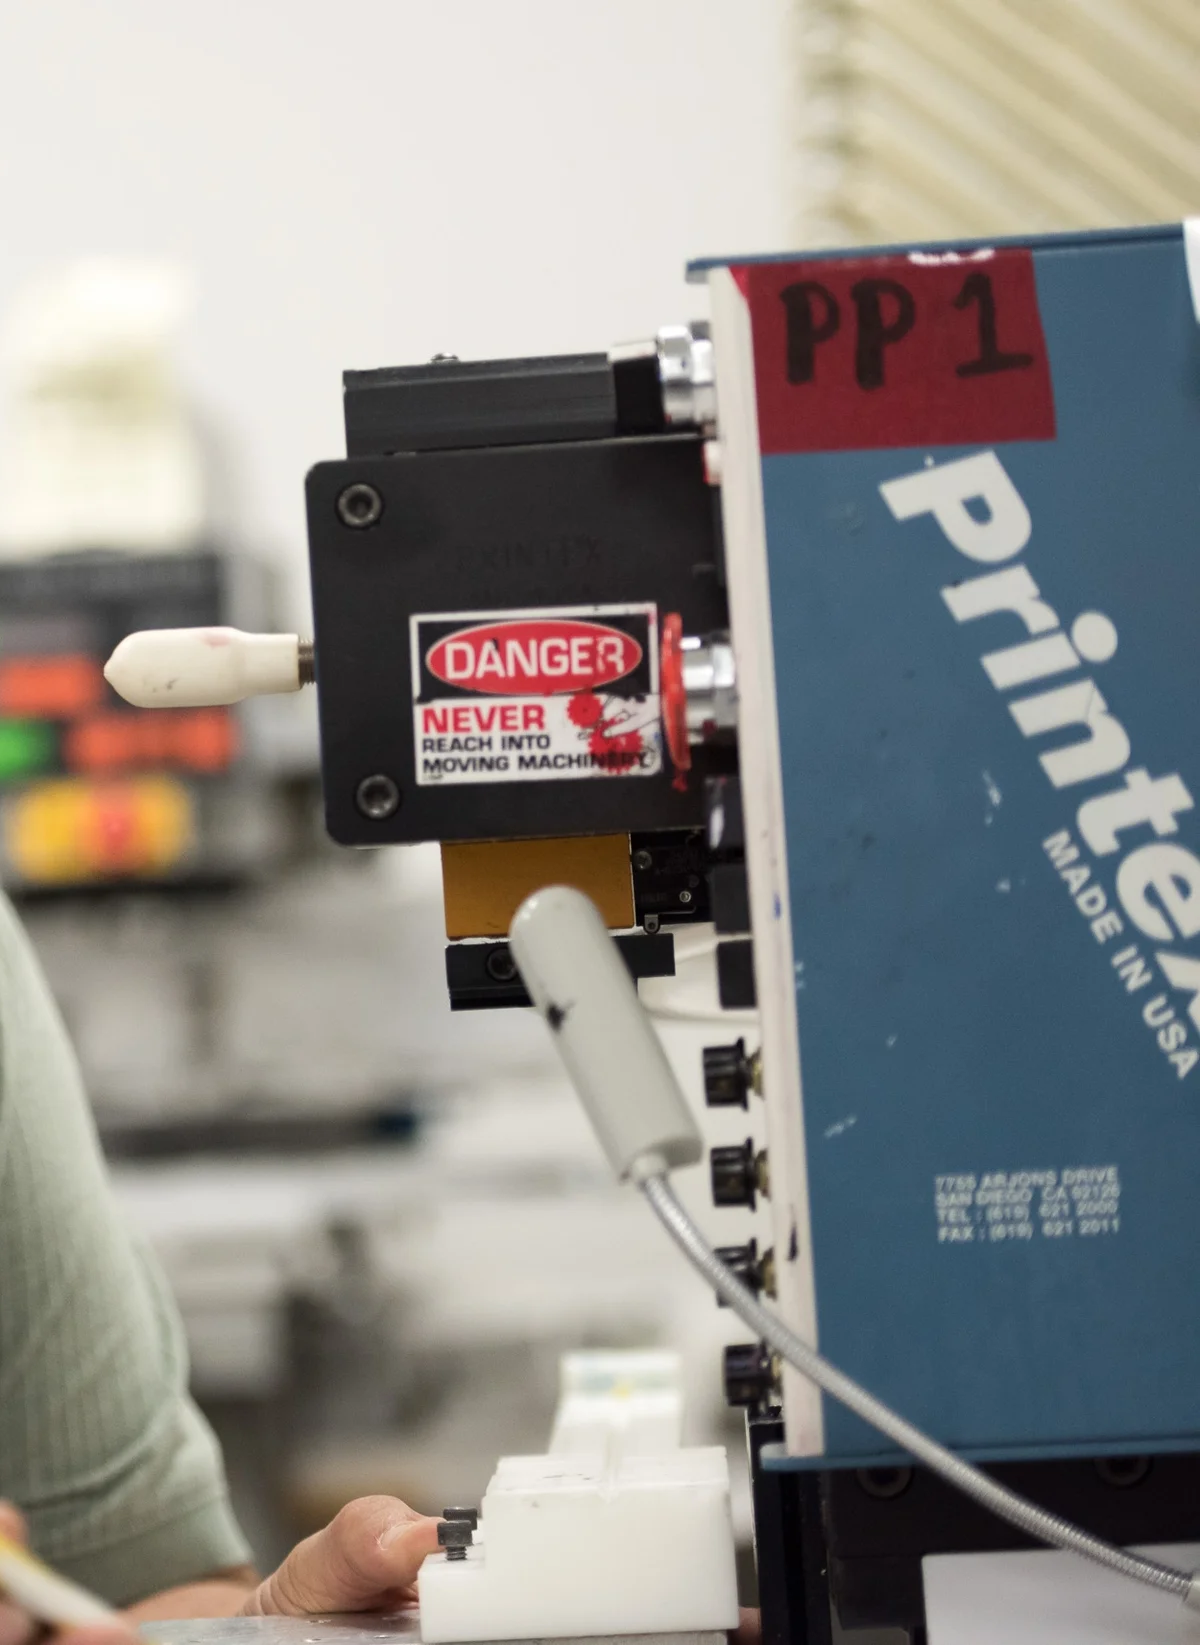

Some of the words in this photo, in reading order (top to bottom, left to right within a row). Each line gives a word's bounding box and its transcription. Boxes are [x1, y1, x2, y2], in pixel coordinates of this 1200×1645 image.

[780, 277, 916, 390] PP
[954, 272, 1034, 378] 1
[445, 636, 625, 679] DANGER
[422, 704, 546, 734] NEVER
[422, 736, 492, 753] REACH
[501, 735, 550, 750] INTO
[423, 756, 509, 773] MOVING
[518, 749, 650, 770] MACHINERY
[1042, 828, 1123, 944] MADE
[1110, 945, 1153, 994] IN
[1141, 995, 1199, 1080] USA
[1062, 1166, 1119, 1185] DRIVE
